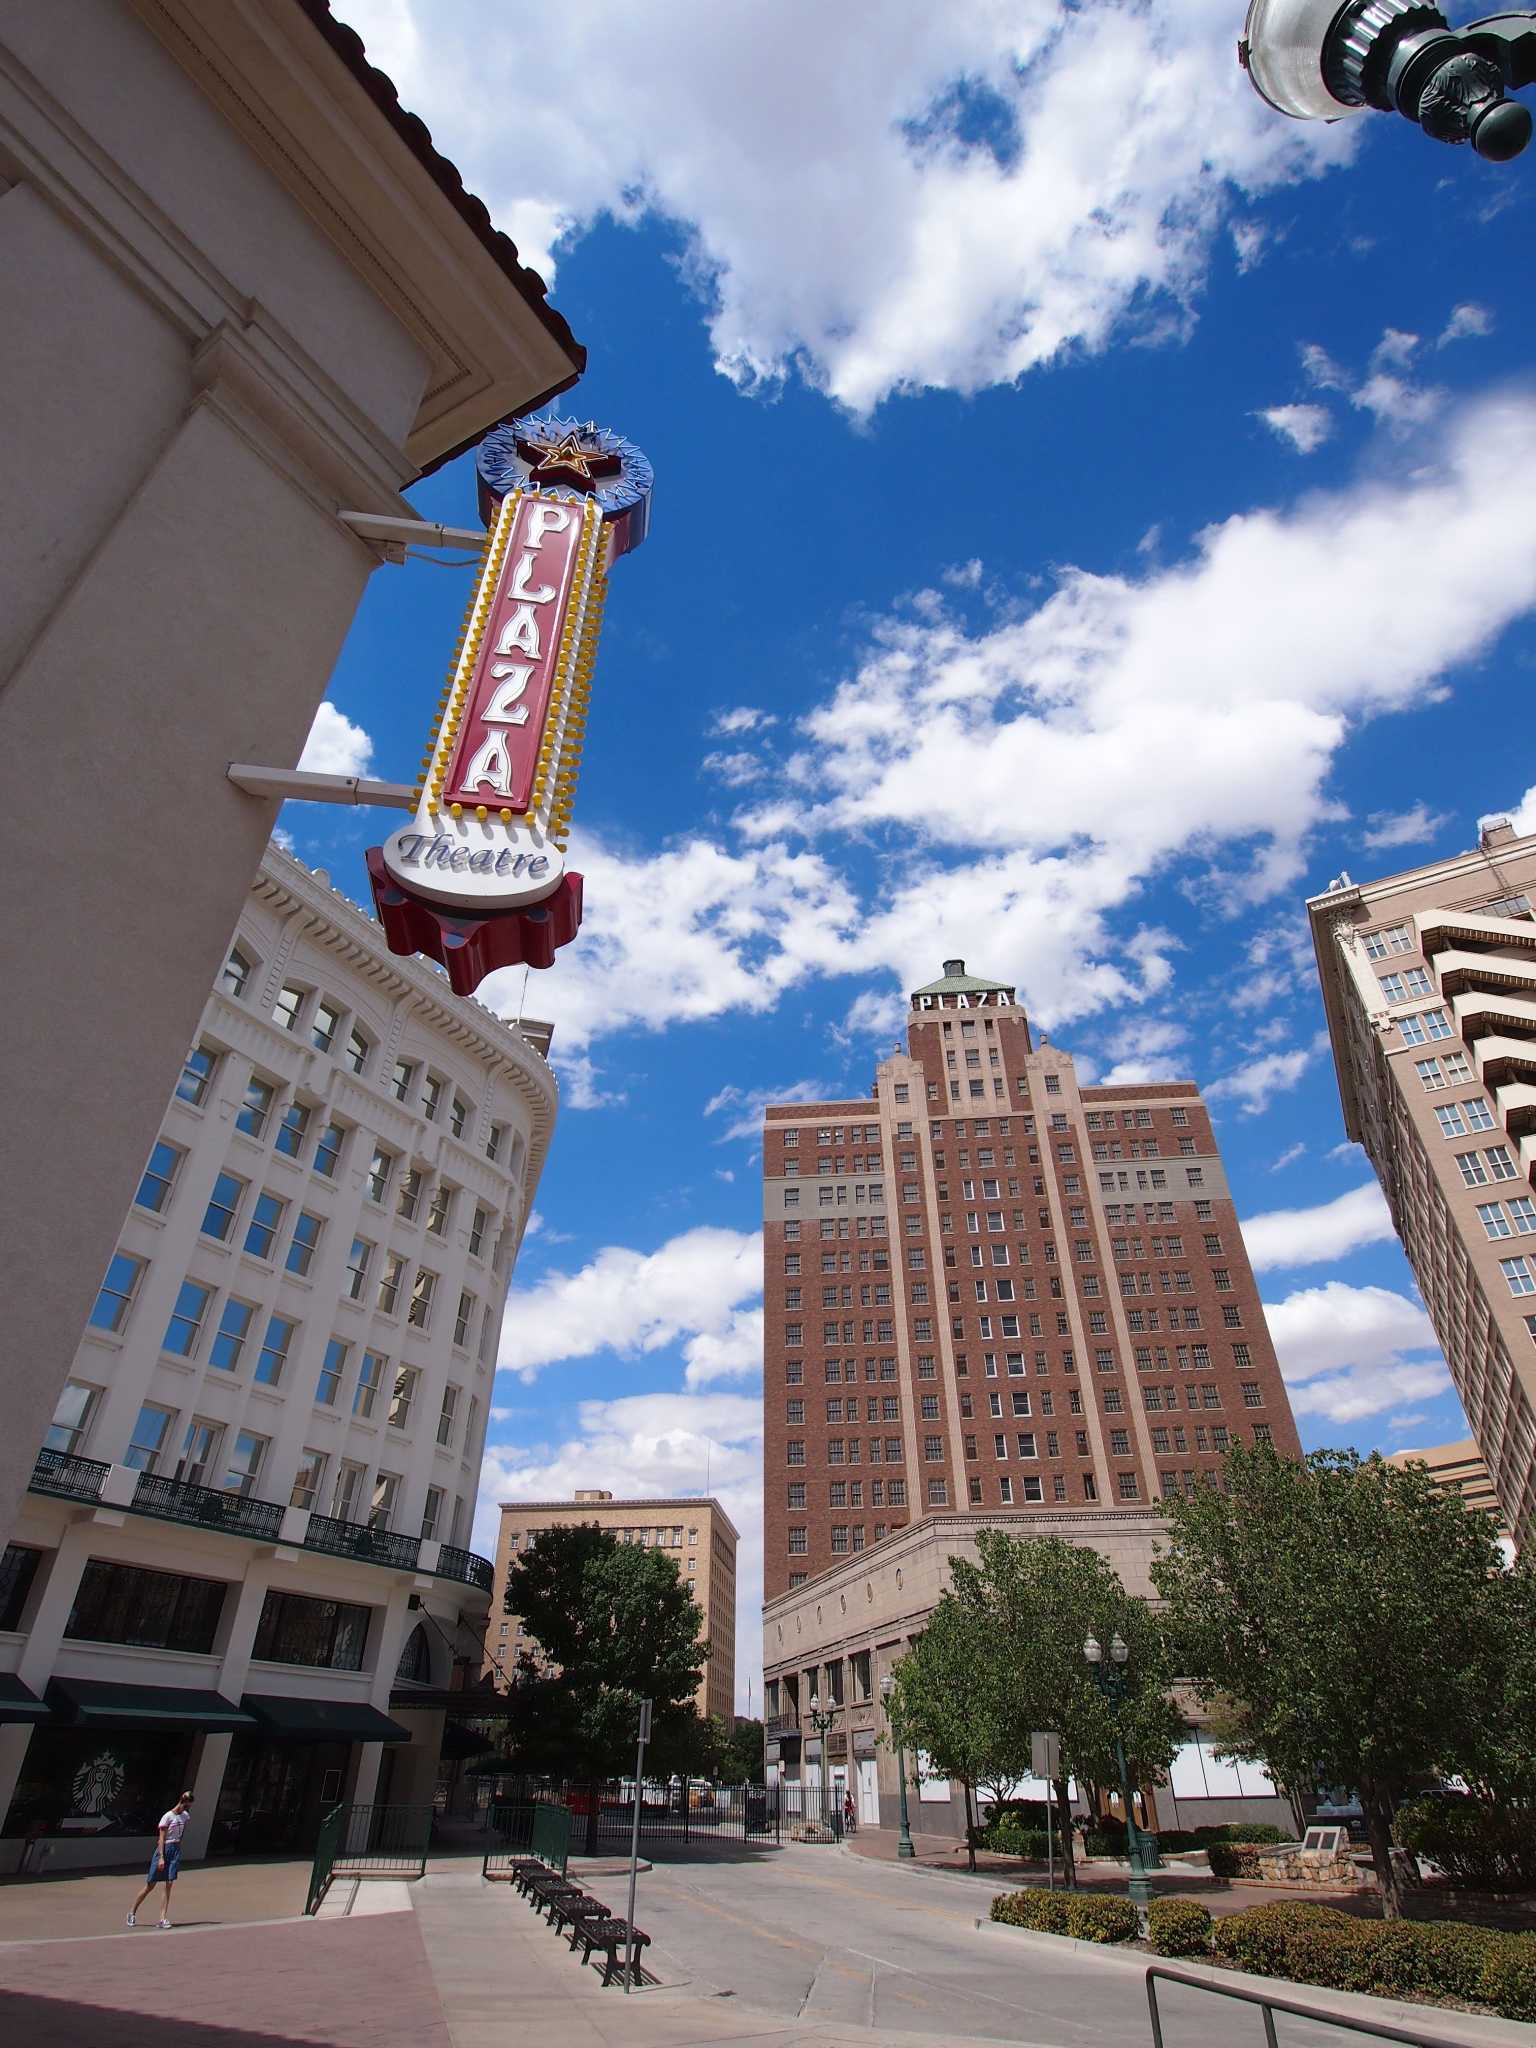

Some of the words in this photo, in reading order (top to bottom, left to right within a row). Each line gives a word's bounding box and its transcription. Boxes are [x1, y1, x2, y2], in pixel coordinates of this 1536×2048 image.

[459, 503, 570, 798] PLAZA
[398, 834, 549, 877] Theatre
[919, 990, 1011, 1011] PLAZA
